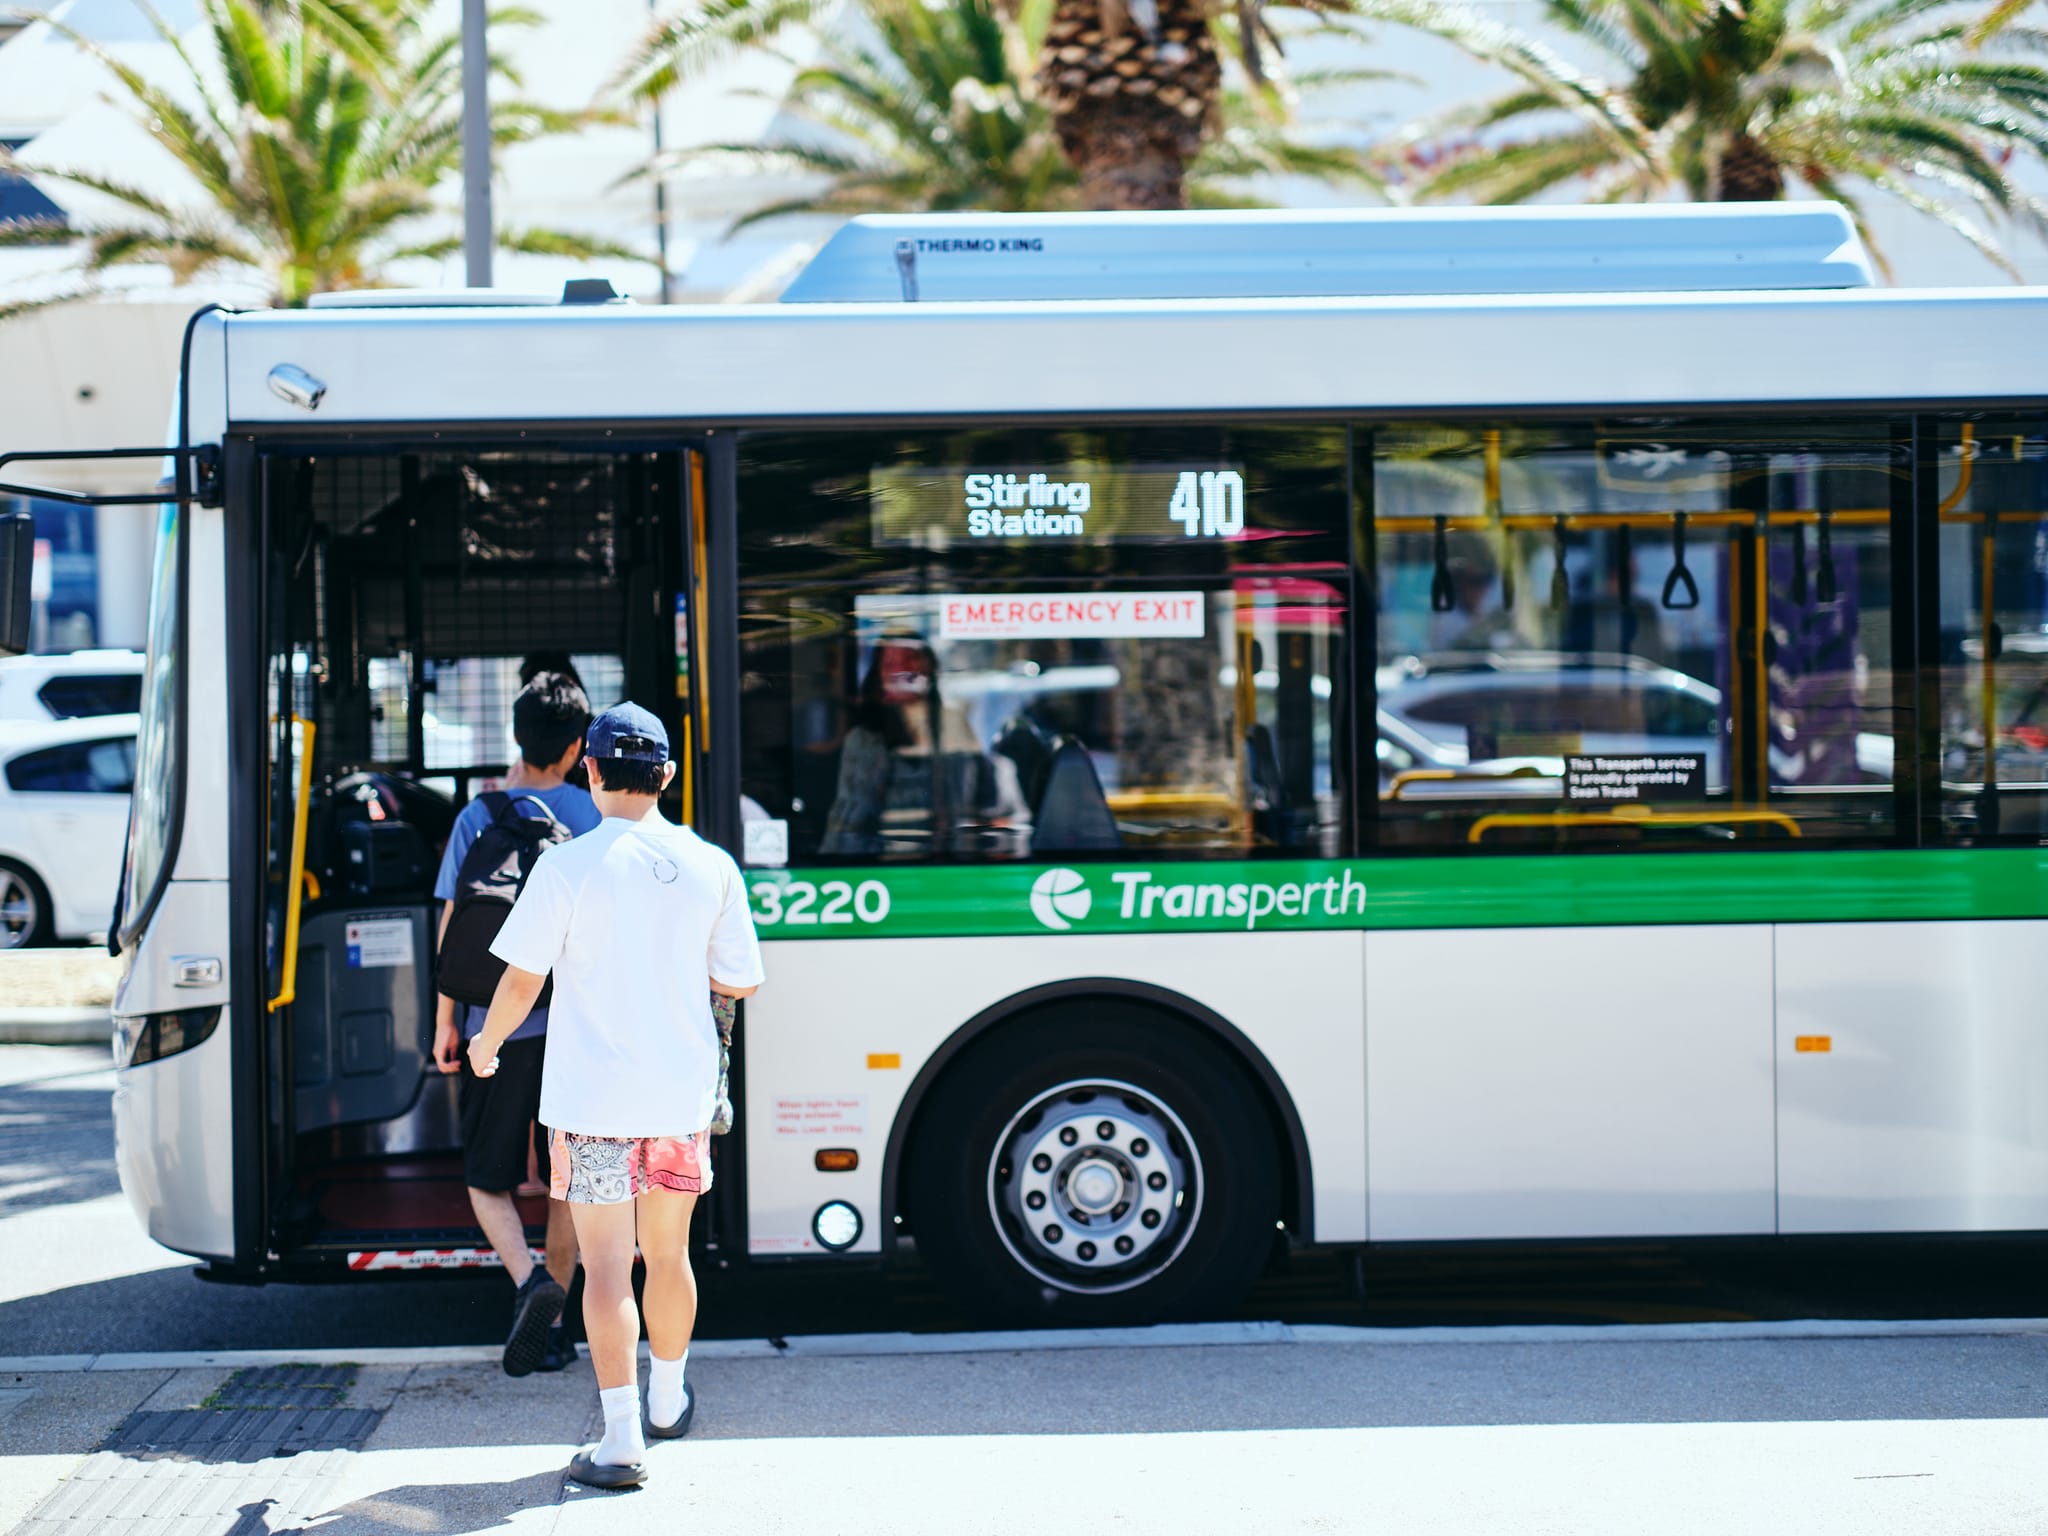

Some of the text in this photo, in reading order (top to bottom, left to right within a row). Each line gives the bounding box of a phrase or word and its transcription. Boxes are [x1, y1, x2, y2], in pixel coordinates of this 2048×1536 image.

[916, 238, 1044, 252] THERMO KING
[964, 472, 1091, 513] Stirling
[1168, 470, 1245, 537] 410
[967, 508, 1084, 537] Station
[947, 599, 1197, 624] EMERGENCY EXIT
[1569, 756, 1697, 773] This Transperth service
[1569, 771, 1690, 786] is proudly operated by
[1569, 784, 1639, 799] Swan Transit
[752, 878, 891, 925] 3220
[1111, 869, 1367, 930] Transperth
